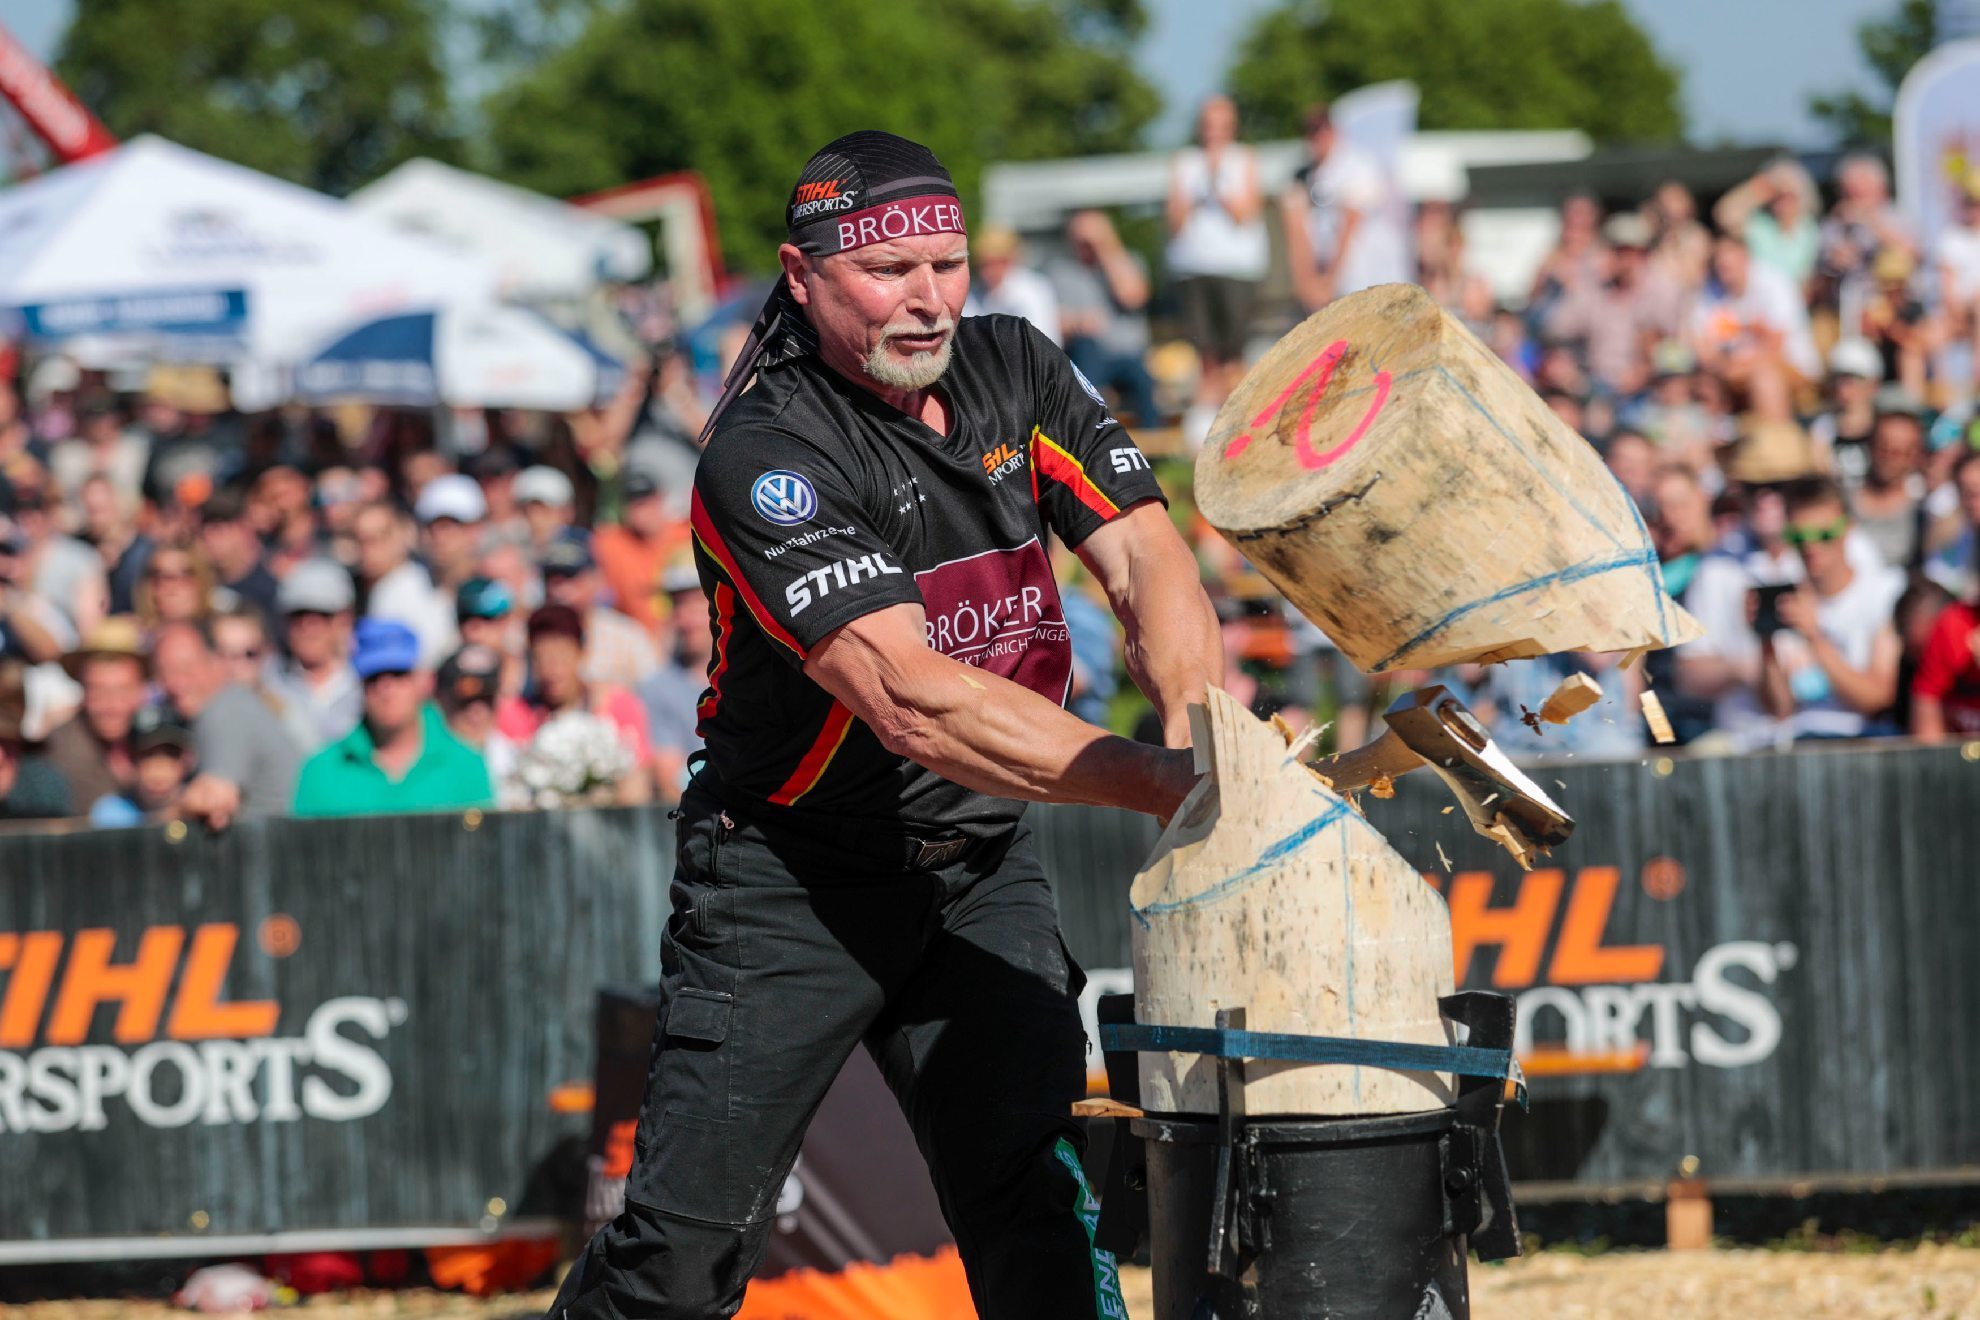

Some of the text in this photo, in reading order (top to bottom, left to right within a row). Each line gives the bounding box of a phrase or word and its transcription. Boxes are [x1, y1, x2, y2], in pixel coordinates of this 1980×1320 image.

[837, 204, 964, 250] BRÖKER
[785, 552, 903, 618] STIHL
[926, 586, 1042, 652] BRÖKER
